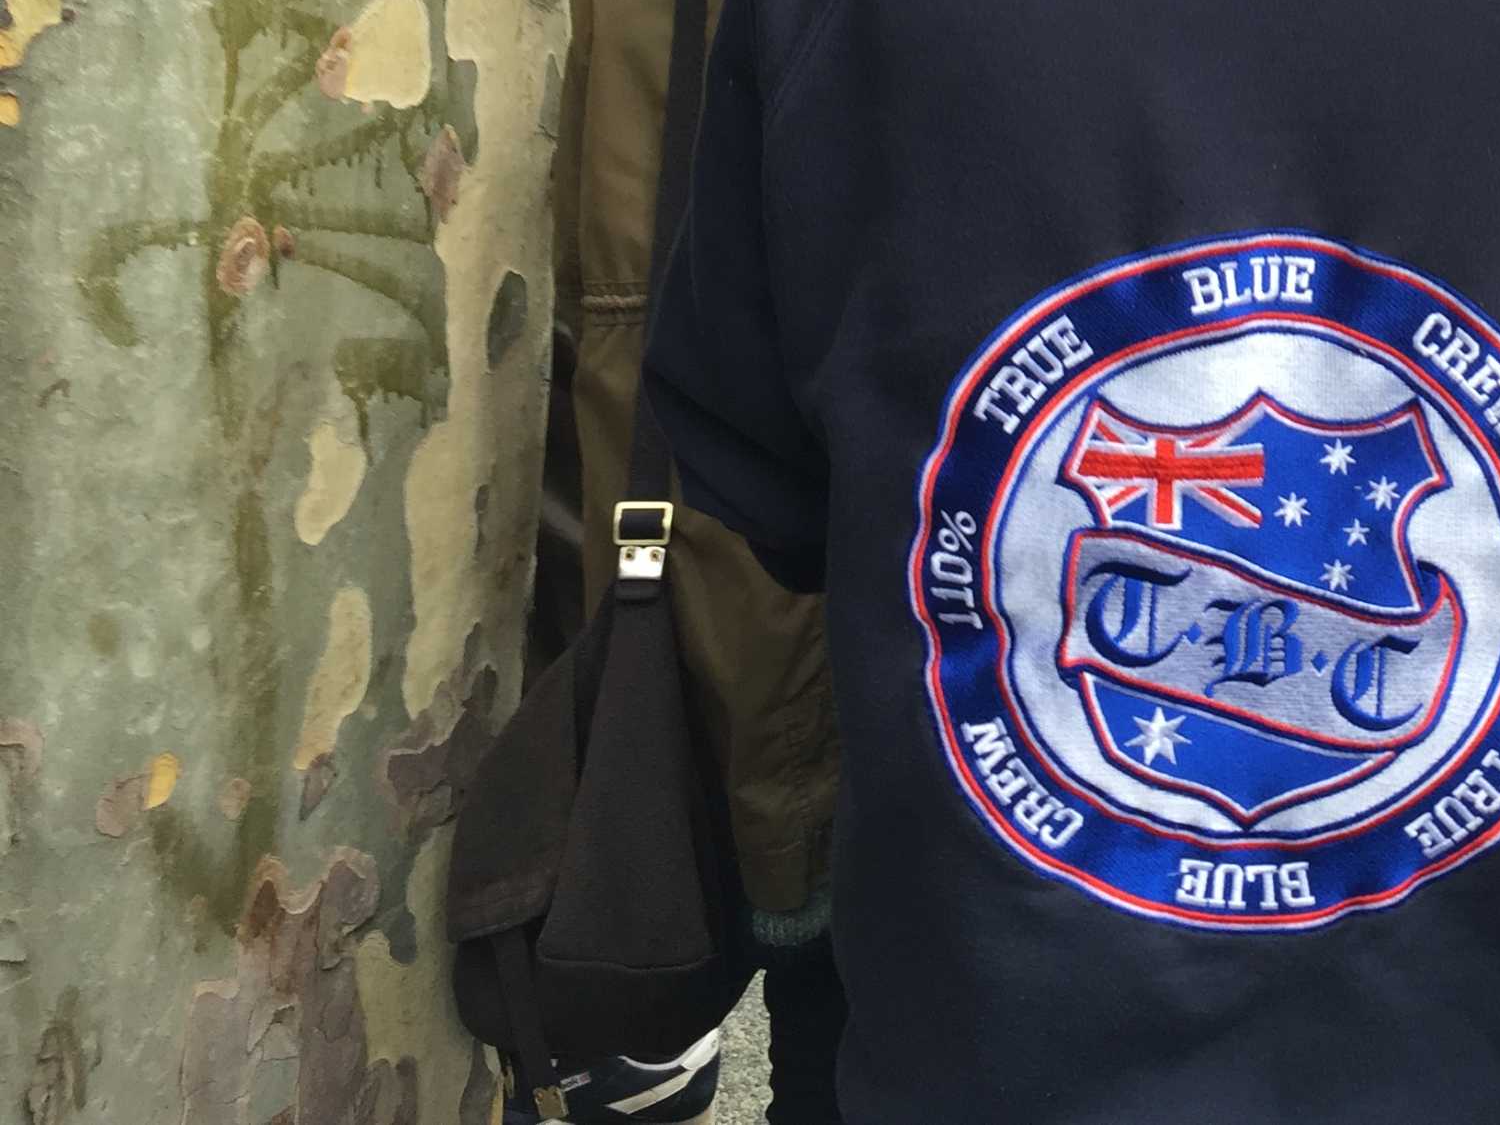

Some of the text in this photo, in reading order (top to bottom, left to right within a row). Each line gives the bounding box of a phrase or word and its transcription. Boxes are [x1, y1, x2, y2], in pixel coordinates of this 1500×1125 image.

[973, 315, 1094, 435] TRUE
[1183, 255, 1316, 317] BLUE
[930, 509, 984, 630] 110%
[961, 717, 1085, 849] CREW
[1177, 858, 1315, 907] BLUE
